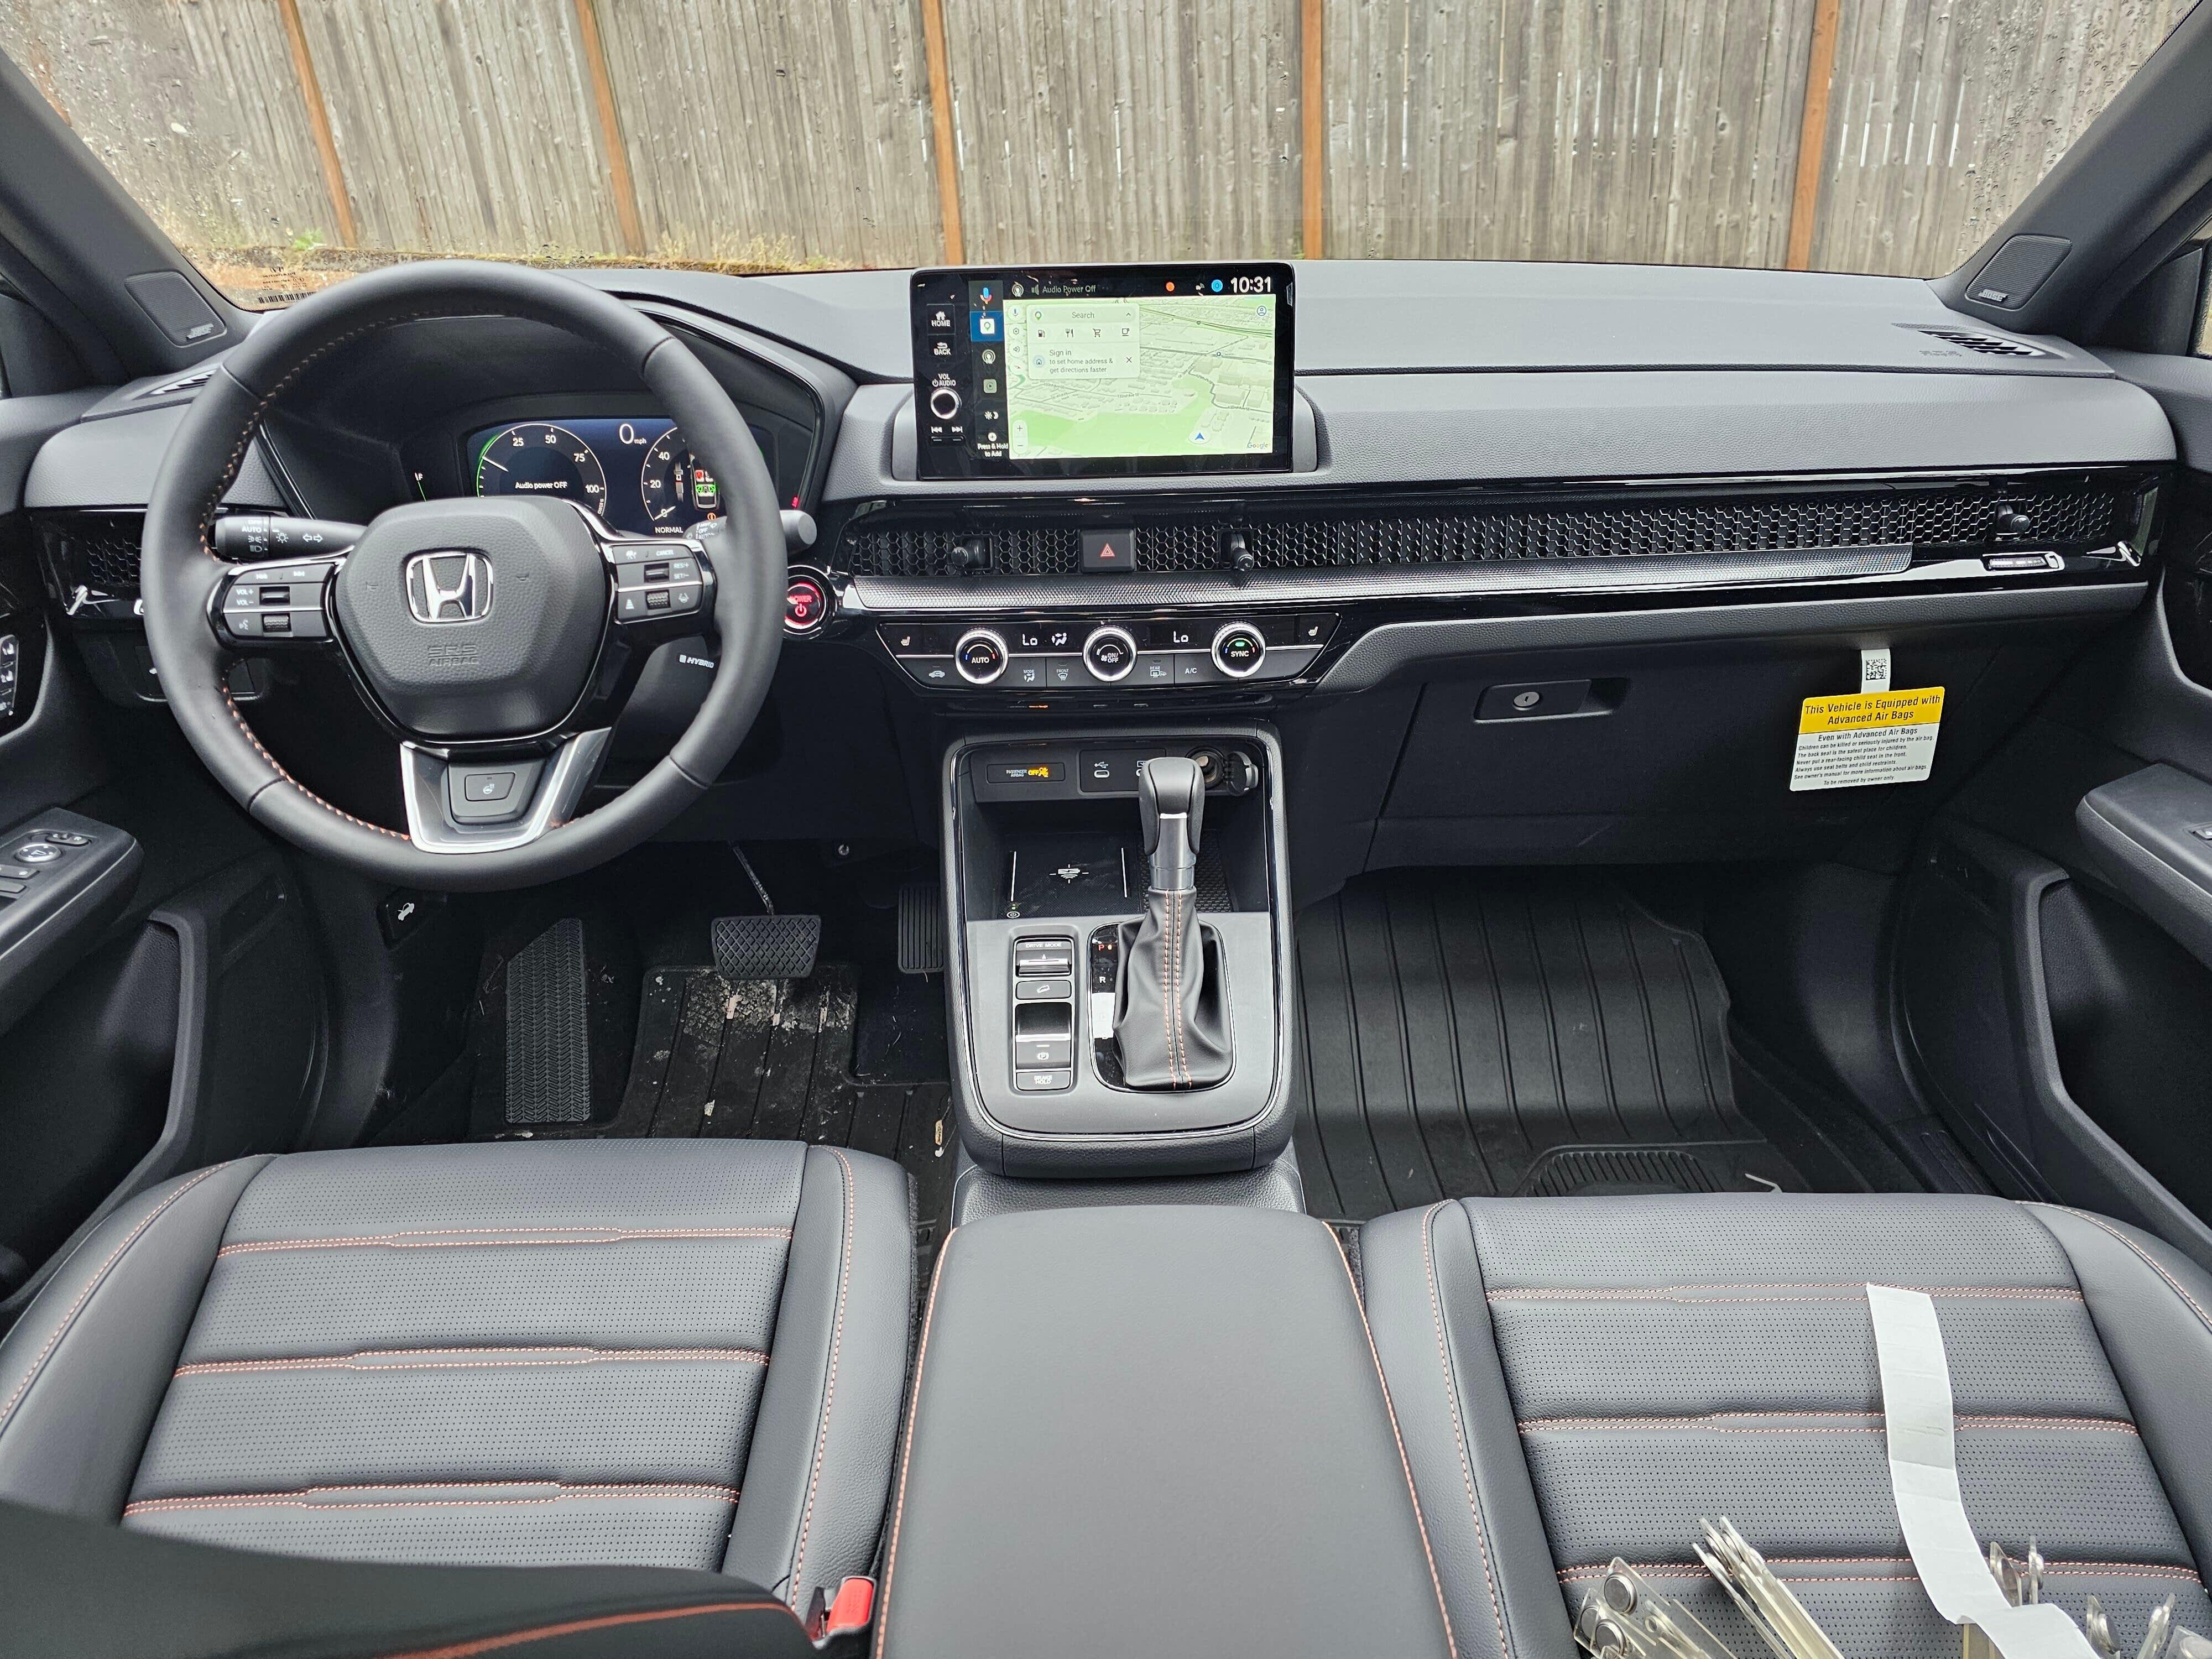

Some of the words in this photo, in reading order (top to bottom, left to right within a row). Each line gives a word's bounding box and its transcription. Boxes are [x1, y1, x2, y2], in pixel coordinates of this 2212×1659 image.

[1063, 285, 1083, 293] Power
[1230, 276, 1271, 293] 10:31
[1049, 349, 1064, 358] Sign
[619, 423, 634, 445] 0
[512, 437, 524, 447] 25
[545, 435, 556, 444] 50
[573, 453, 586, 462] 75
[658, 452, 670, 461] 40
[534, 482, 554, 490] power
[649, 479, 661, 488] 20
[585, 484, 599, 493] 100
[686, 656, 714, 669] HYBRID
[1805, 705, 1824, 714] This
[1828, 702, 1861, 713] Vehicle
[1865, 701, 1872, 709] is
[1875, 697, 1918, 709] Equipped
[1921, 695, 1940, 705] with
[1827, 714, 1872, 726] Advanced
[1875, 712, 1889, 721] Air
[1892, 711, 1914, 721] Bags
[1853, 729, 1887, 739] Advanced
